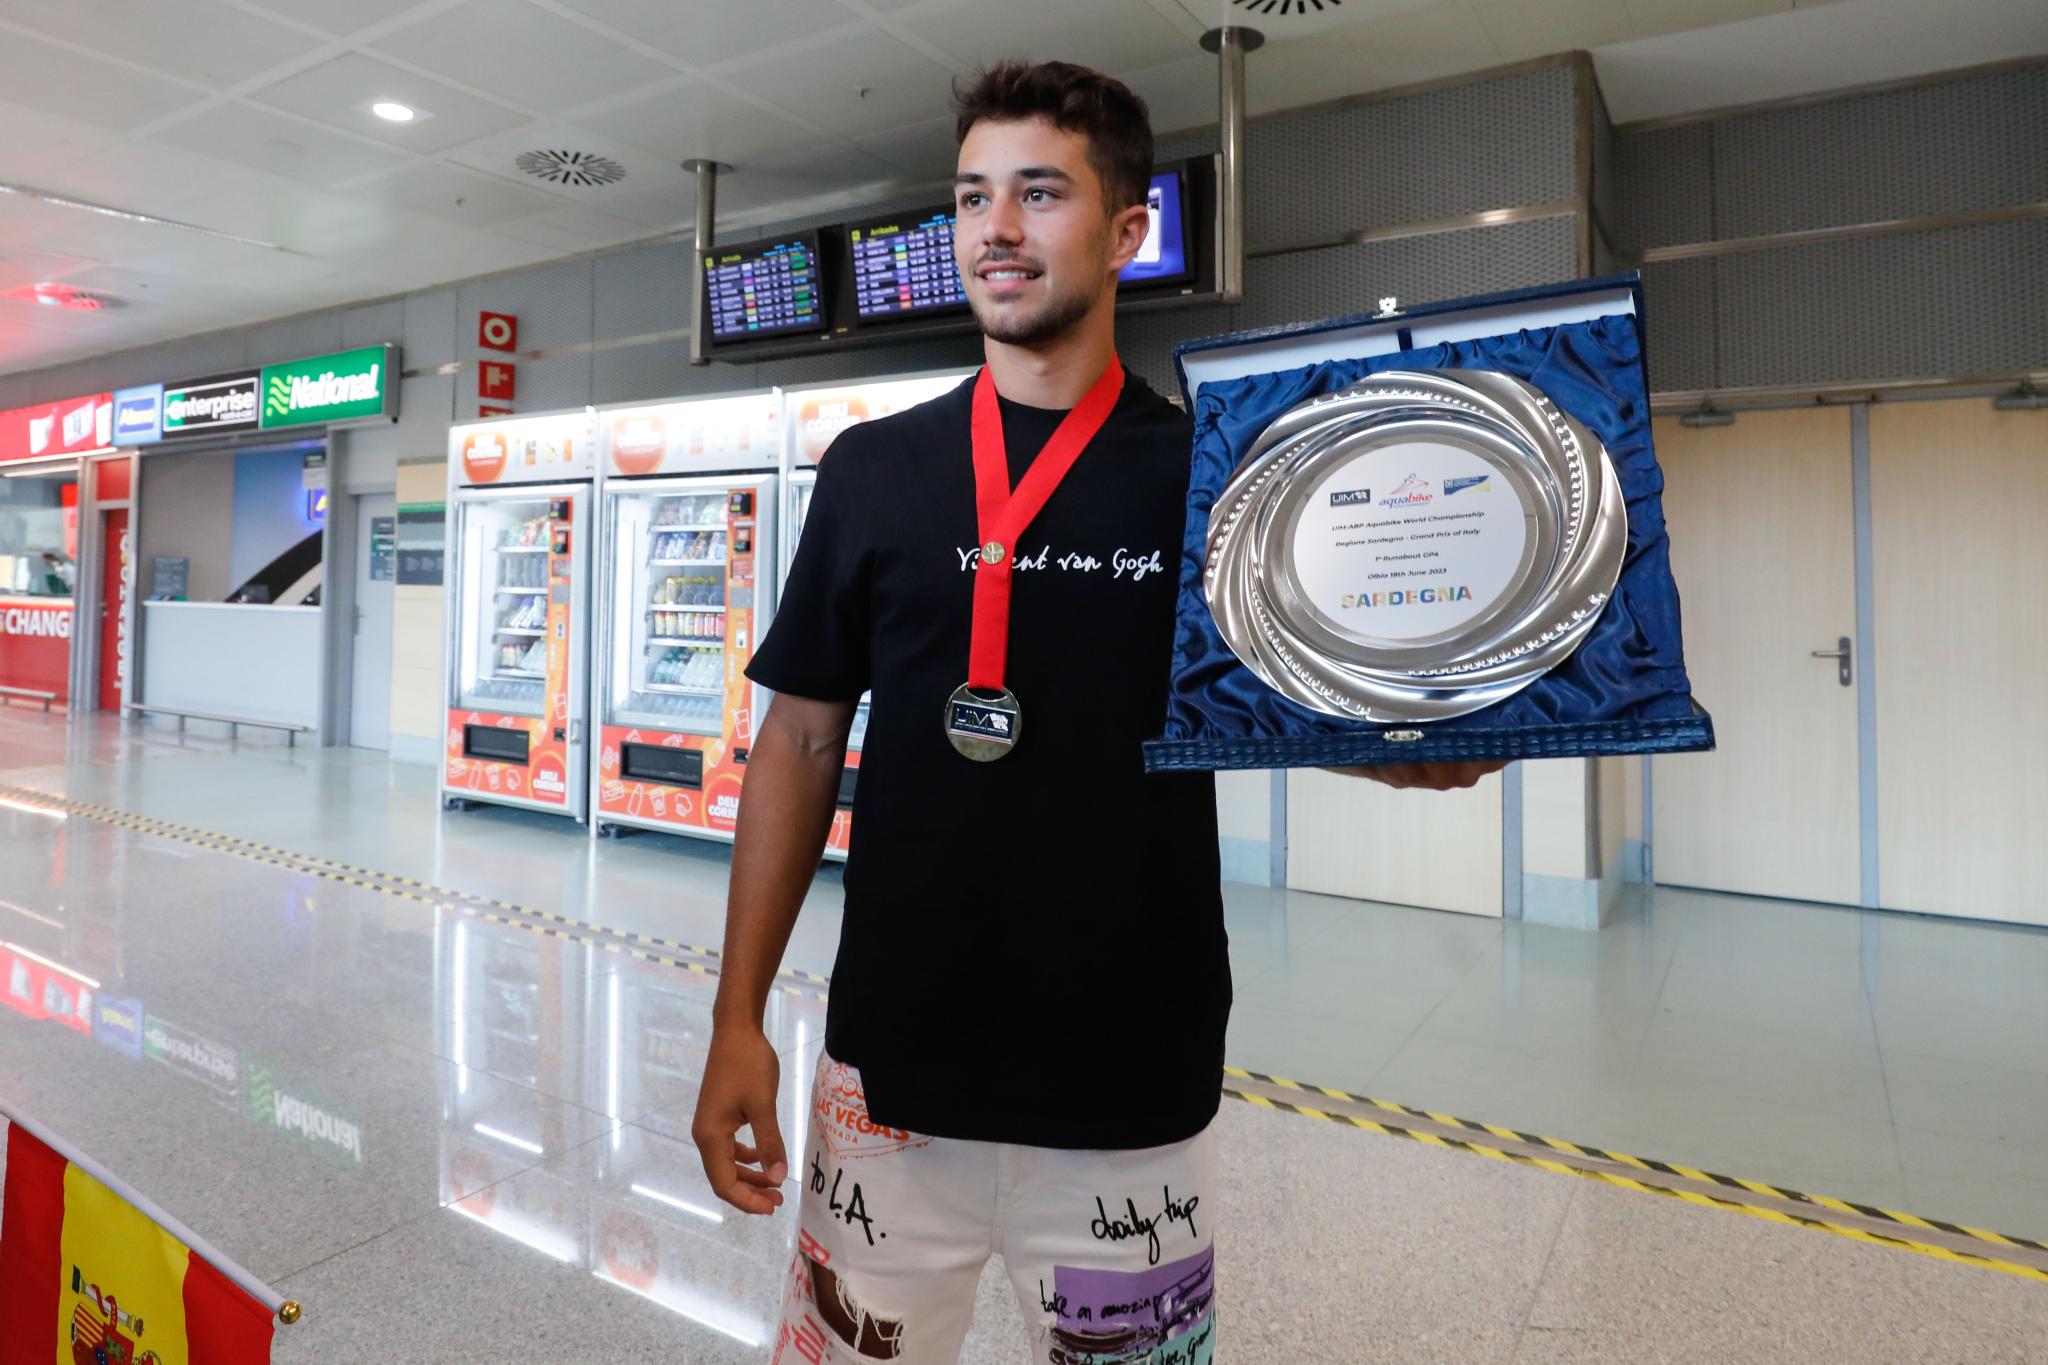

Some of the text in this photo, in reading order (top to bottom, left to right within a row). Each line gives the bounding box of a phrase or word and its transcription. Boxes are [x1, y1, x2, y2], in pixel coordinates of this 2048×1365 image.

[288, 364, 379, 410] National
[164, 388, 255, 420] enterprise
[1379, 492, 1433, 509] aquabike
[1403, 517, 1426, 525] World
[1427, 511, 1485, 523] Championship
[1367, 536, 1404, 545] Sardegna
[1410, 532, 1435, 541] Grand
[1436, 530, 1451, 538] Prix
[1452, 529, 1462, 537] of
[1057, 552, 1102, 572] van
[1112, 547, 1164, 581] Gogh
[1407, 568, 1427, 577] June
[1428, 567, 1448, 576] 2023
[1341, 584, 1473, 609] SARDEGNA
[810, 1151, 887, 1246] to L.A.
[1091, 1184, 1200, 1265] daily trip
[1039, 1278, 1072, 1319] take
[1076, 1304, 1092, 1323] an
